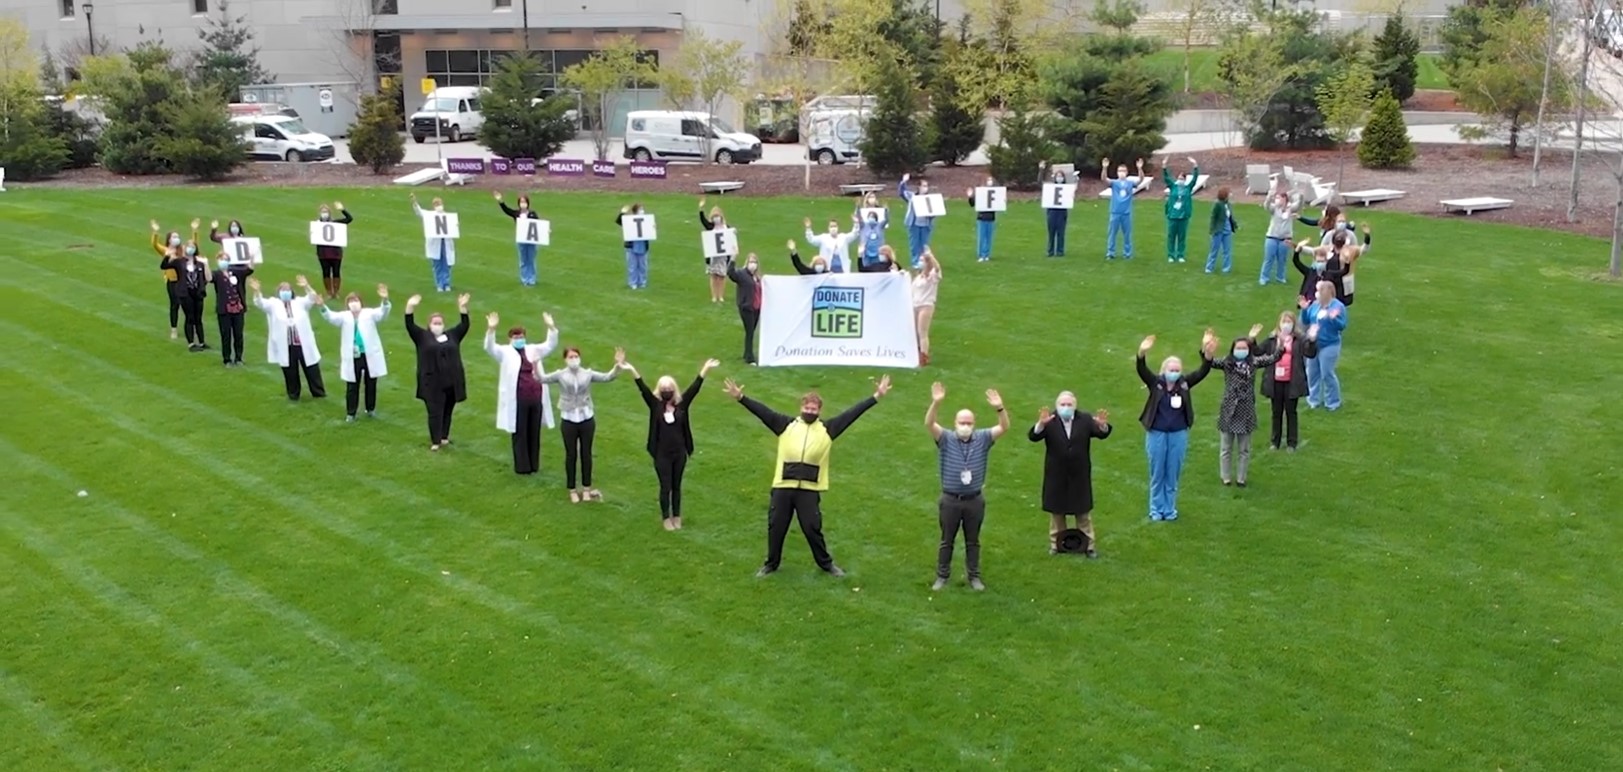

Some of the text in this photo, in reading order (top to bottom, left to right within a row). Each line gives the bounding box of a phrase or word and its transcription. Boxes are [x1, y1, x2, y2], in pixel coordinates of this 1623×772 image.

[449, 162, 482, 171] THANKS
[495, 163, 507, 171] TO
[517, 163, 535, 172] OUR
[548, 164, 583, 172] HEALTH
[593, 165, 615, 174] CARE
[631, 165, 665, 175] HEROES
[987, 190, 996, 209] F
[1053, 187, 1063, 206] E
[322, 224, 335, 242] O
[434, 215, 448, 236] N
[526, 222, 539, 242] A
[632, 218, 645, 239] T
[235, 242, 251, 261] D
[714, 233, 727, 254] E
[816, 290, 860, 303] DONATE
[816, 313, 859, 333] LIFE
[774, 345, 907, 359] Donation Saves Lives
